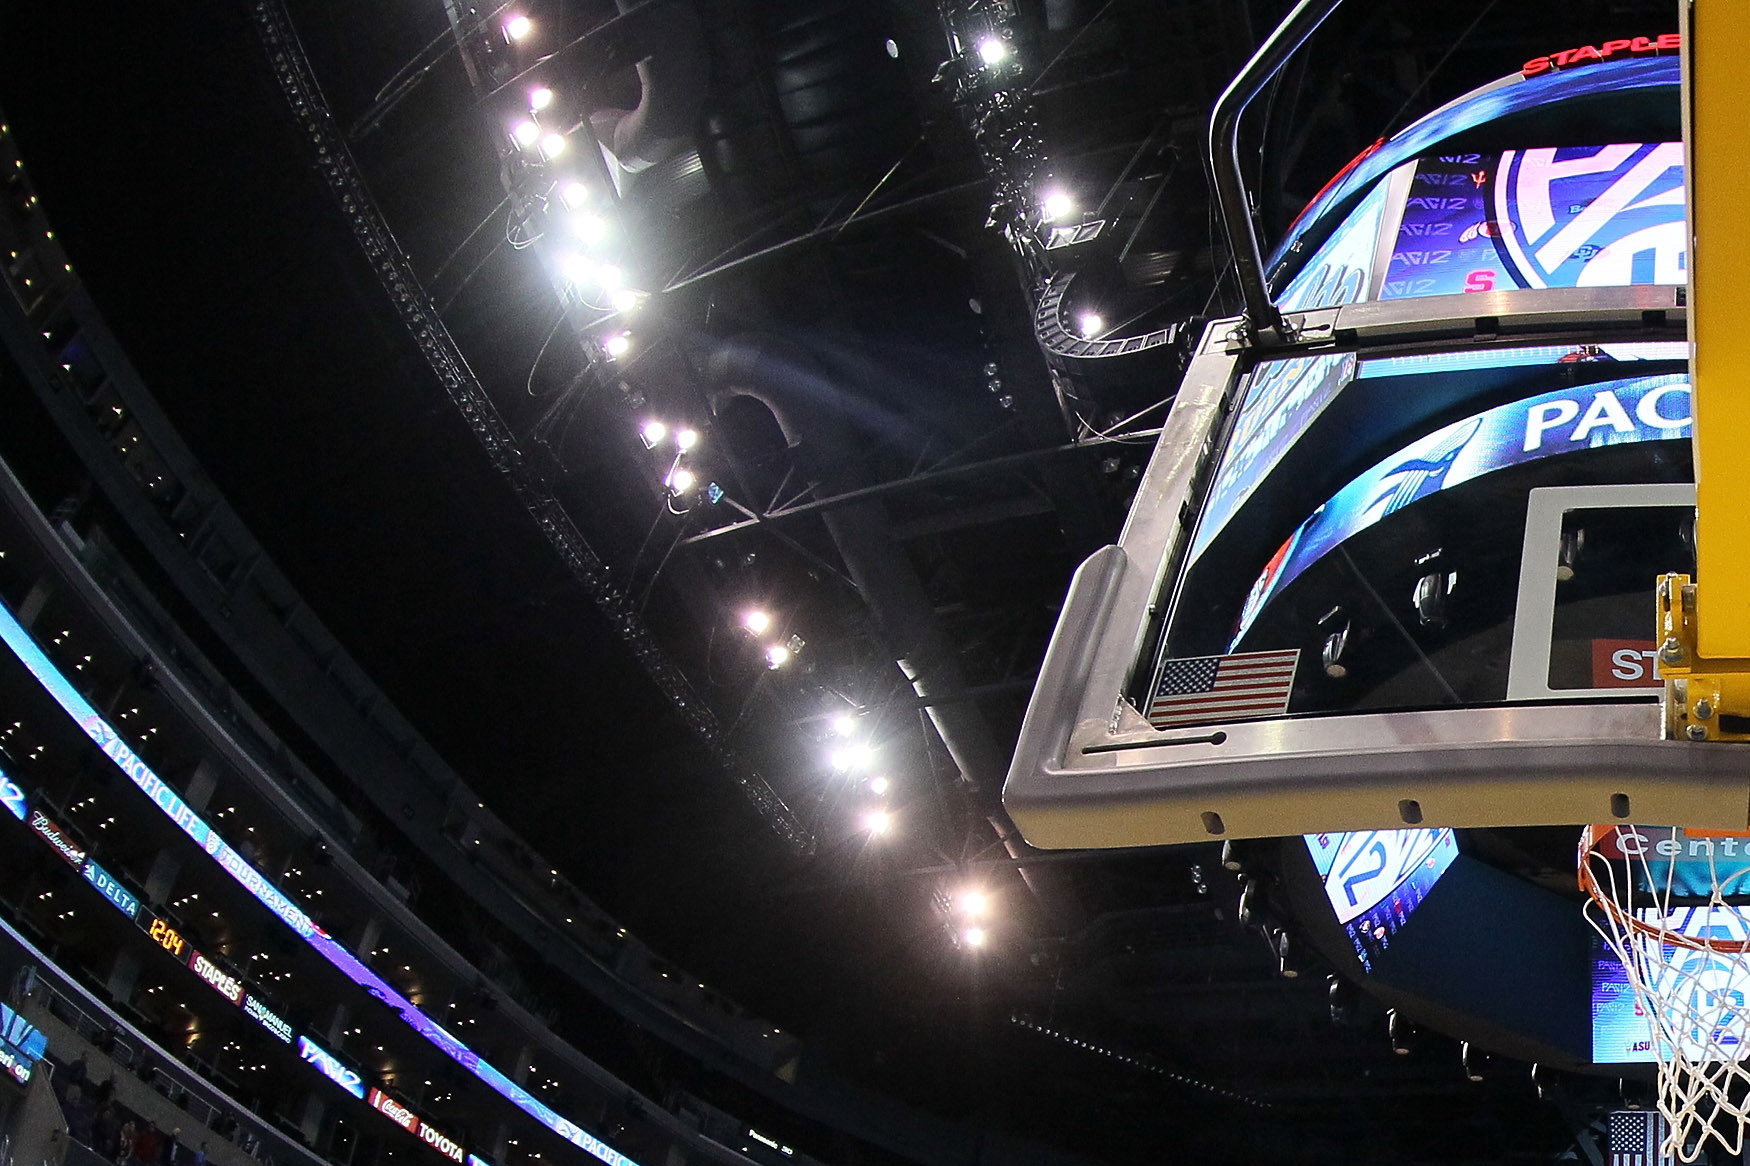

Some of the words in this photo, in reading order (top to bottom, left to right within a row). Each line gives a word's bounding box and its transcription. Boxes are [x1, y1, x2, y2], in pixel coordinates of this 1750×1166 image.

[1521, 33, 1682, 76] STAPLE
[114, 746, 171, 807] PACIFIC
[168, 796, 201, 838] LIFE
[219, 845, 317, 940] TOURNAMENT
[96, 873, 136, 916] DELTA
[149, 917, 186, 956] 12:04
[192, 954, 244, 1002] STAPLES
[418, 1122, 464, 1164] TOYOTA
